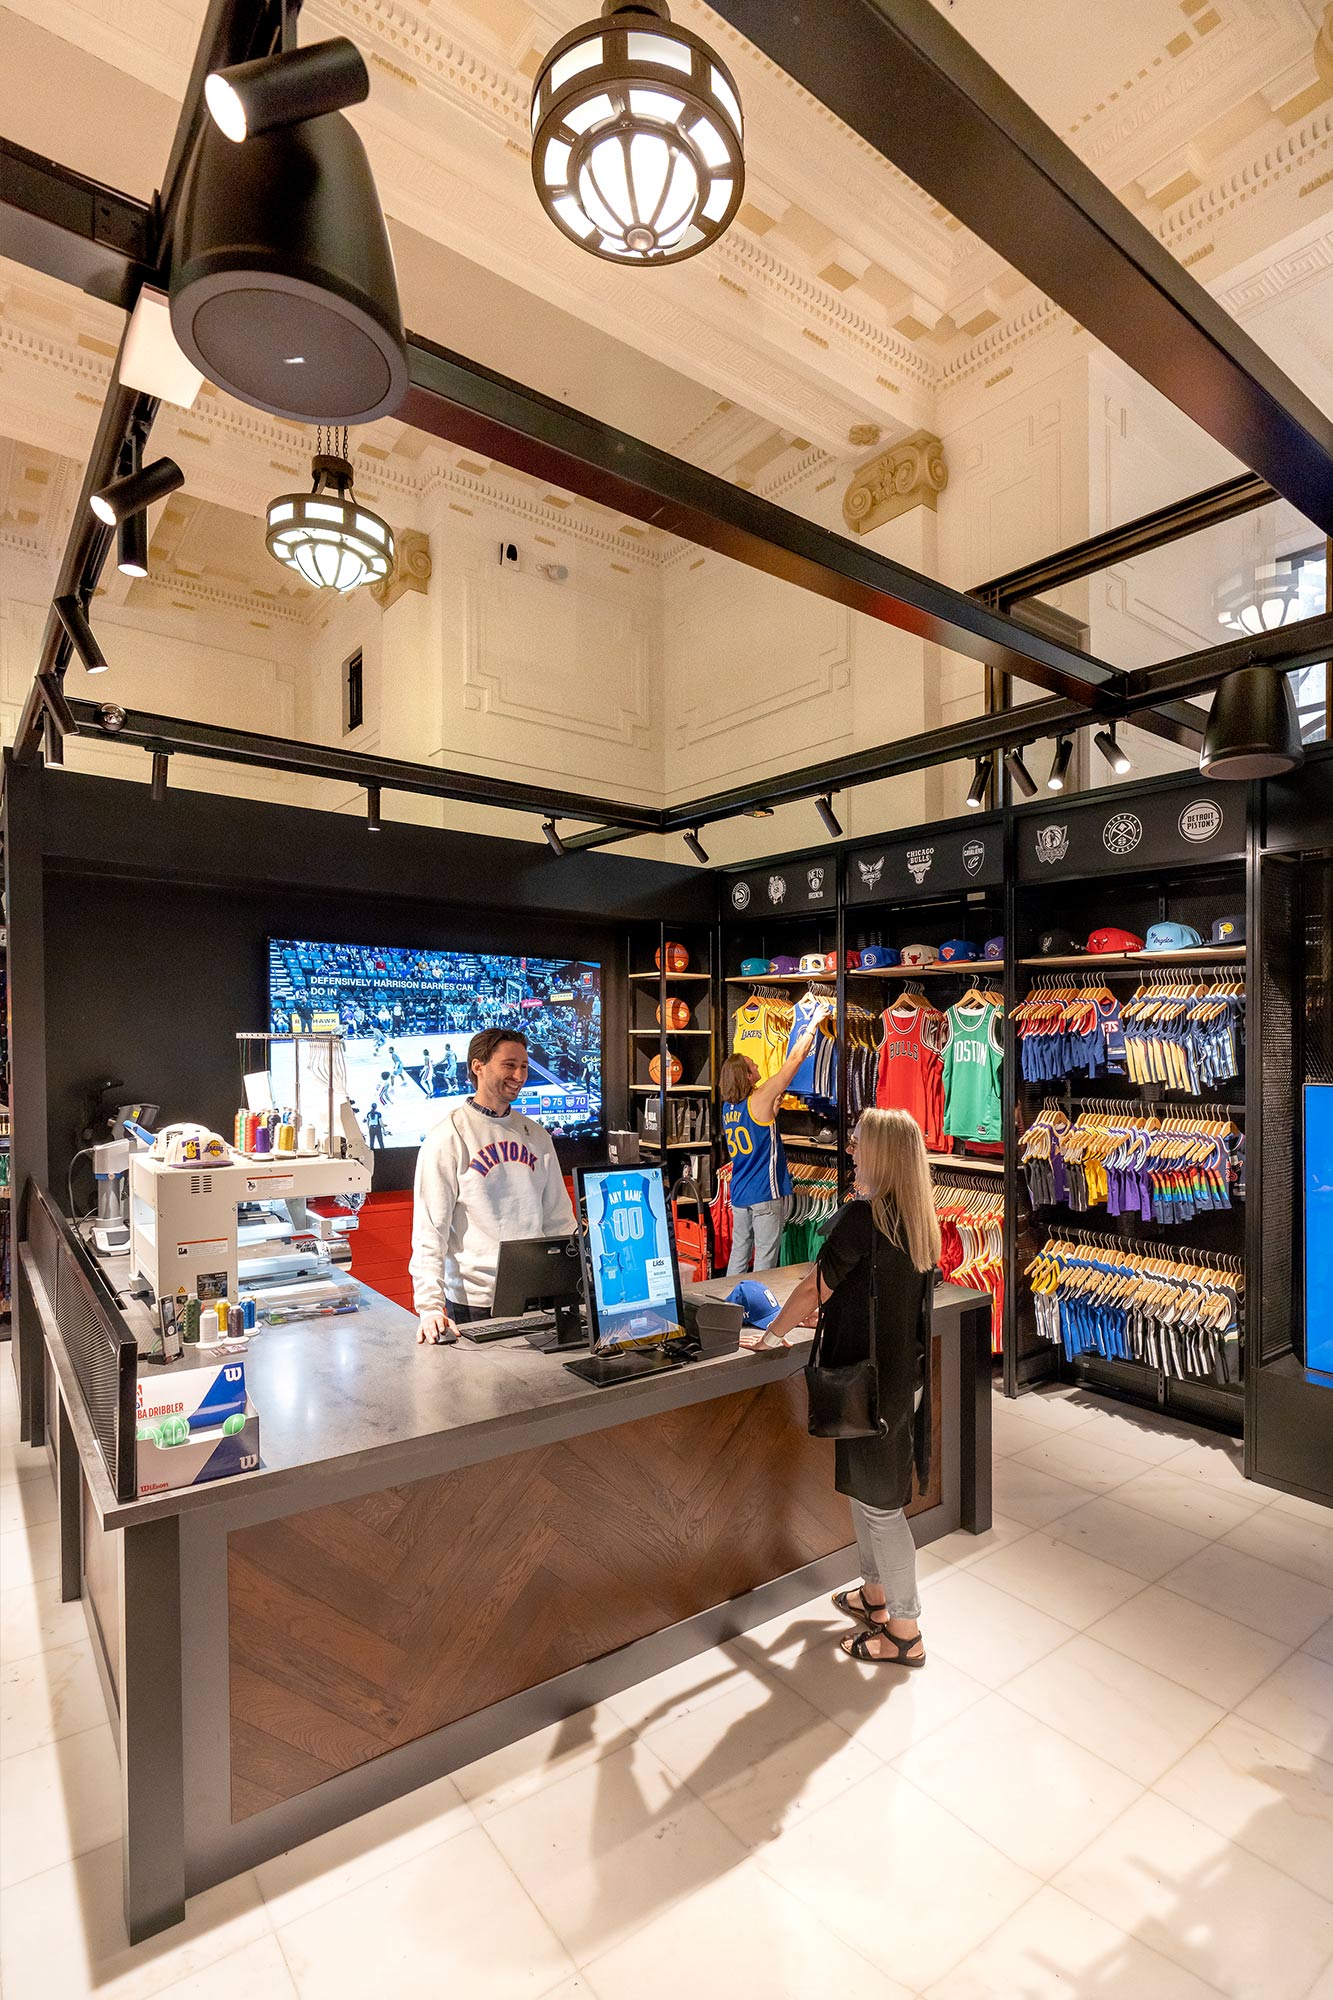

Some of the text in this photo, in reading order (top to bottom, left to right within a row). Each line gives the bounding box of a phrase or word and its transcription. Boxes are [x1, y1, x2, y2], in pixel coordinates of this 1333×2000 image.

[1187, 812, 1214, 822] DETROIT
[1187, 820, 1214, 830] PISTONS
[906, 847, 935, 858] CHICAGO
[910, 855, 930, 864] BULLS
[310, 976, 474, 991] DEFENSIVELY HARRISON BARNES CAN
[310, 987, 337, 996] DO IN
[741, 1029, 763, 1041] LAKERS
[889, 1040, 919, 1061] BULLS
[552, 1097, 563, 1106] 75
[575, 1096, 586, 1105] 70
[725, 1126, 753, 1158] 30
[469, 1140, 538, 1178] NEW YORK
[608, 1189, 643, 1205] ANY NAME
[613, 1206, 645, 1242] 00
[652, 1259, 665, 1267] Lids
[137, 1402, 184, 1419] BA DRIBBLER
[140, 1481, 169, 1493] Wilson
